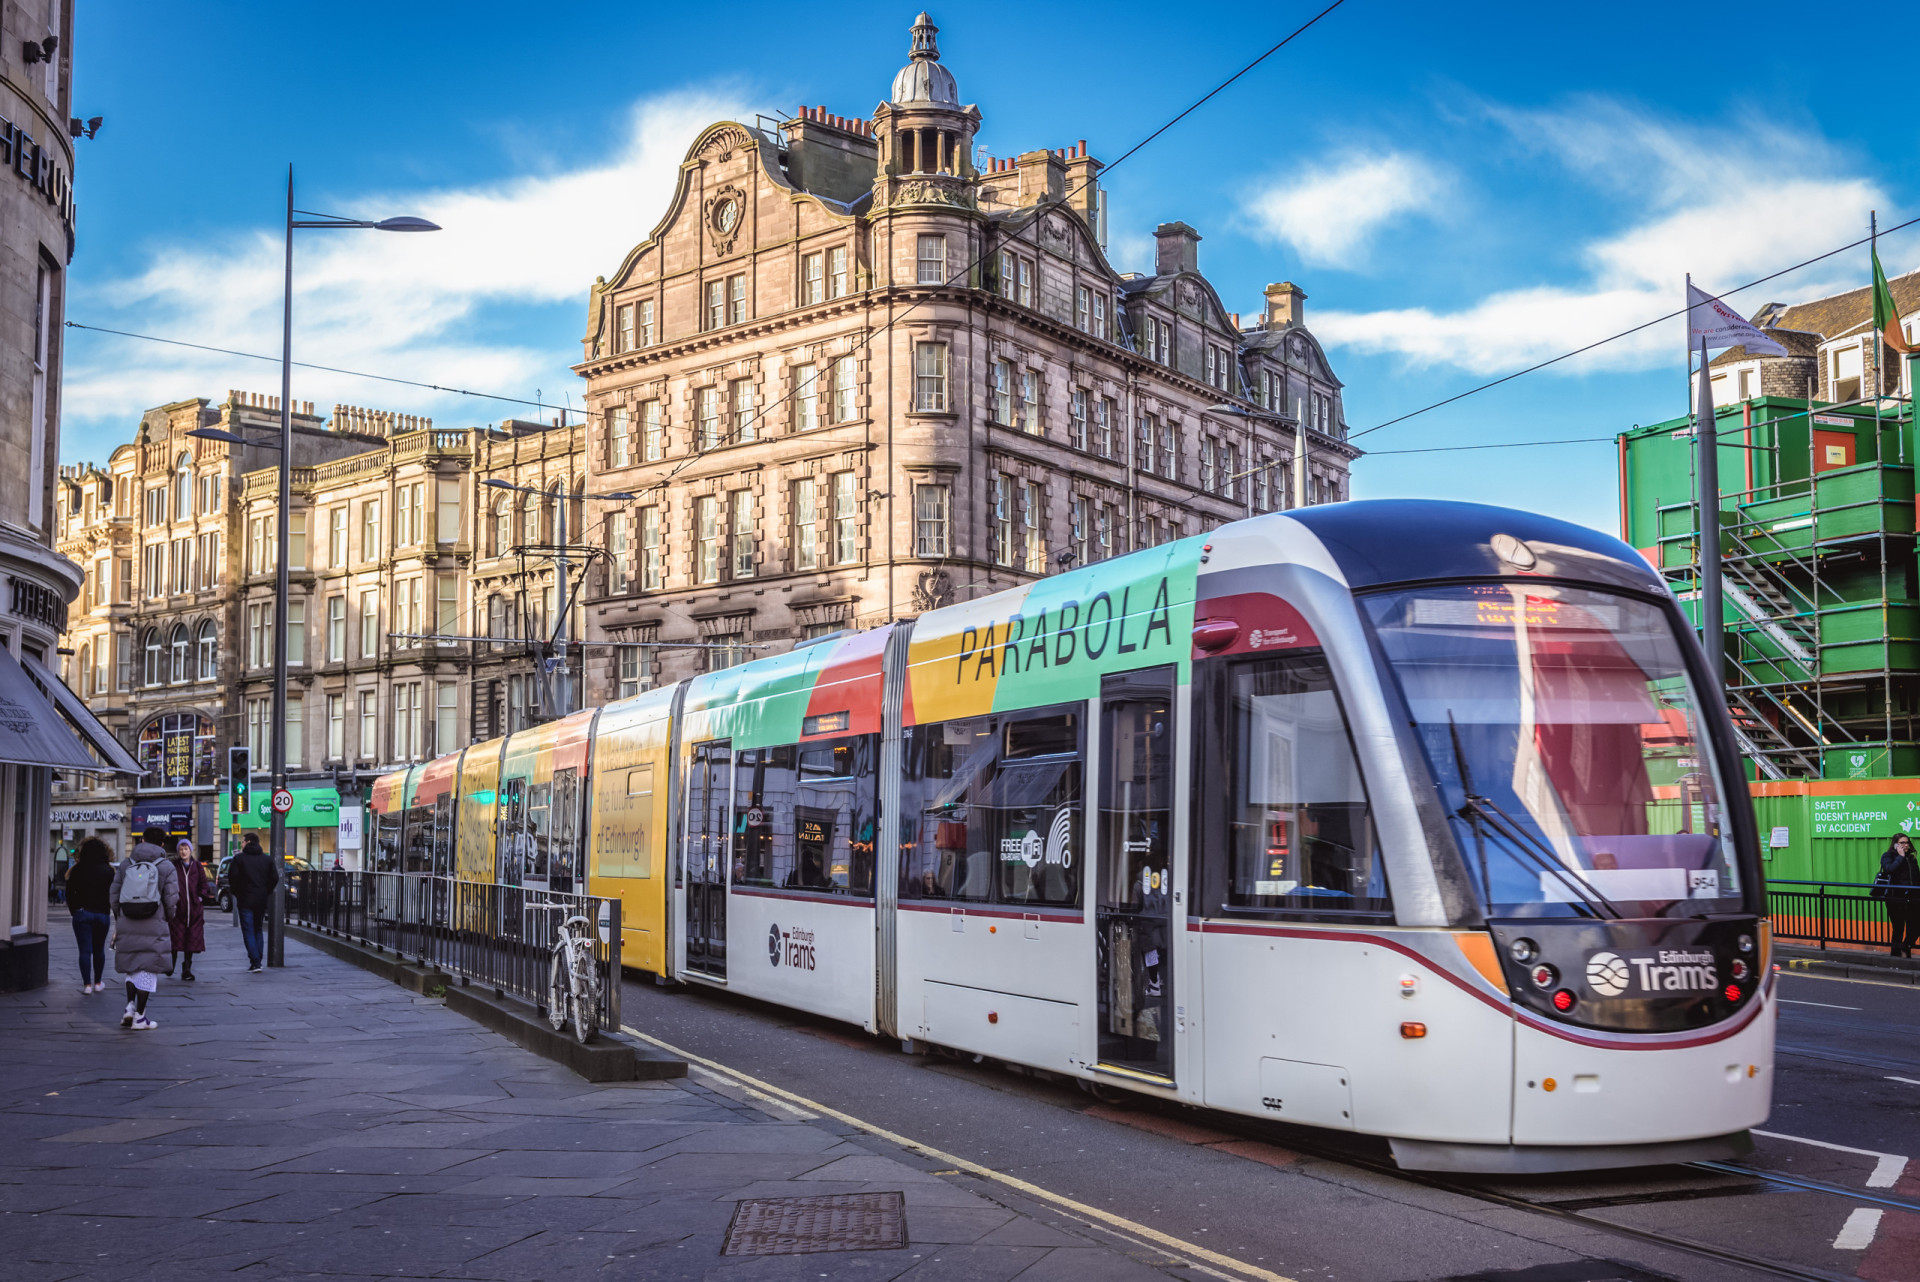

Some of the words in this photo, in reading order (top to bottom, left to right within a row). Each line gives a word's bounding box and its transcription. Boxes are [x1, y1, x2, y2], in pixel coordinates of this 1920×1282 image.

[957, 576, 1171, 685] PARABOLA
[167, 736, 190, 748] LATEST
[167, 756, 190, 767] LATEST
[167, 766, 189, 777] GAMES
[275, 796, 291, 806] 20
[1815, 801, 1846, 810] SAFETY
[54, 811, 70, 822] BANK
[70, 810, 79, 821] OF
[147, 814, 170, 823] ADMIRAL
[1815, 812, 1850, 822] DOESN'T
[1852, 811, 1887, 821] HAPPEN
[1816, 824, 1827, 833] BY
[1829, 823, 1871, 833] ACCIDENT
[597, 825, 604, 853] of
[605, 822, 645, 861] Edinburgh
[1000, 838, 1021, 852] FREE
[793, 926, 815, 946] Edinburgh
[782, 931, 816, 972] Trams
[1658, 950, 1716, 966] Edinburgh
[1629, 957, 1719, 991] Trams
